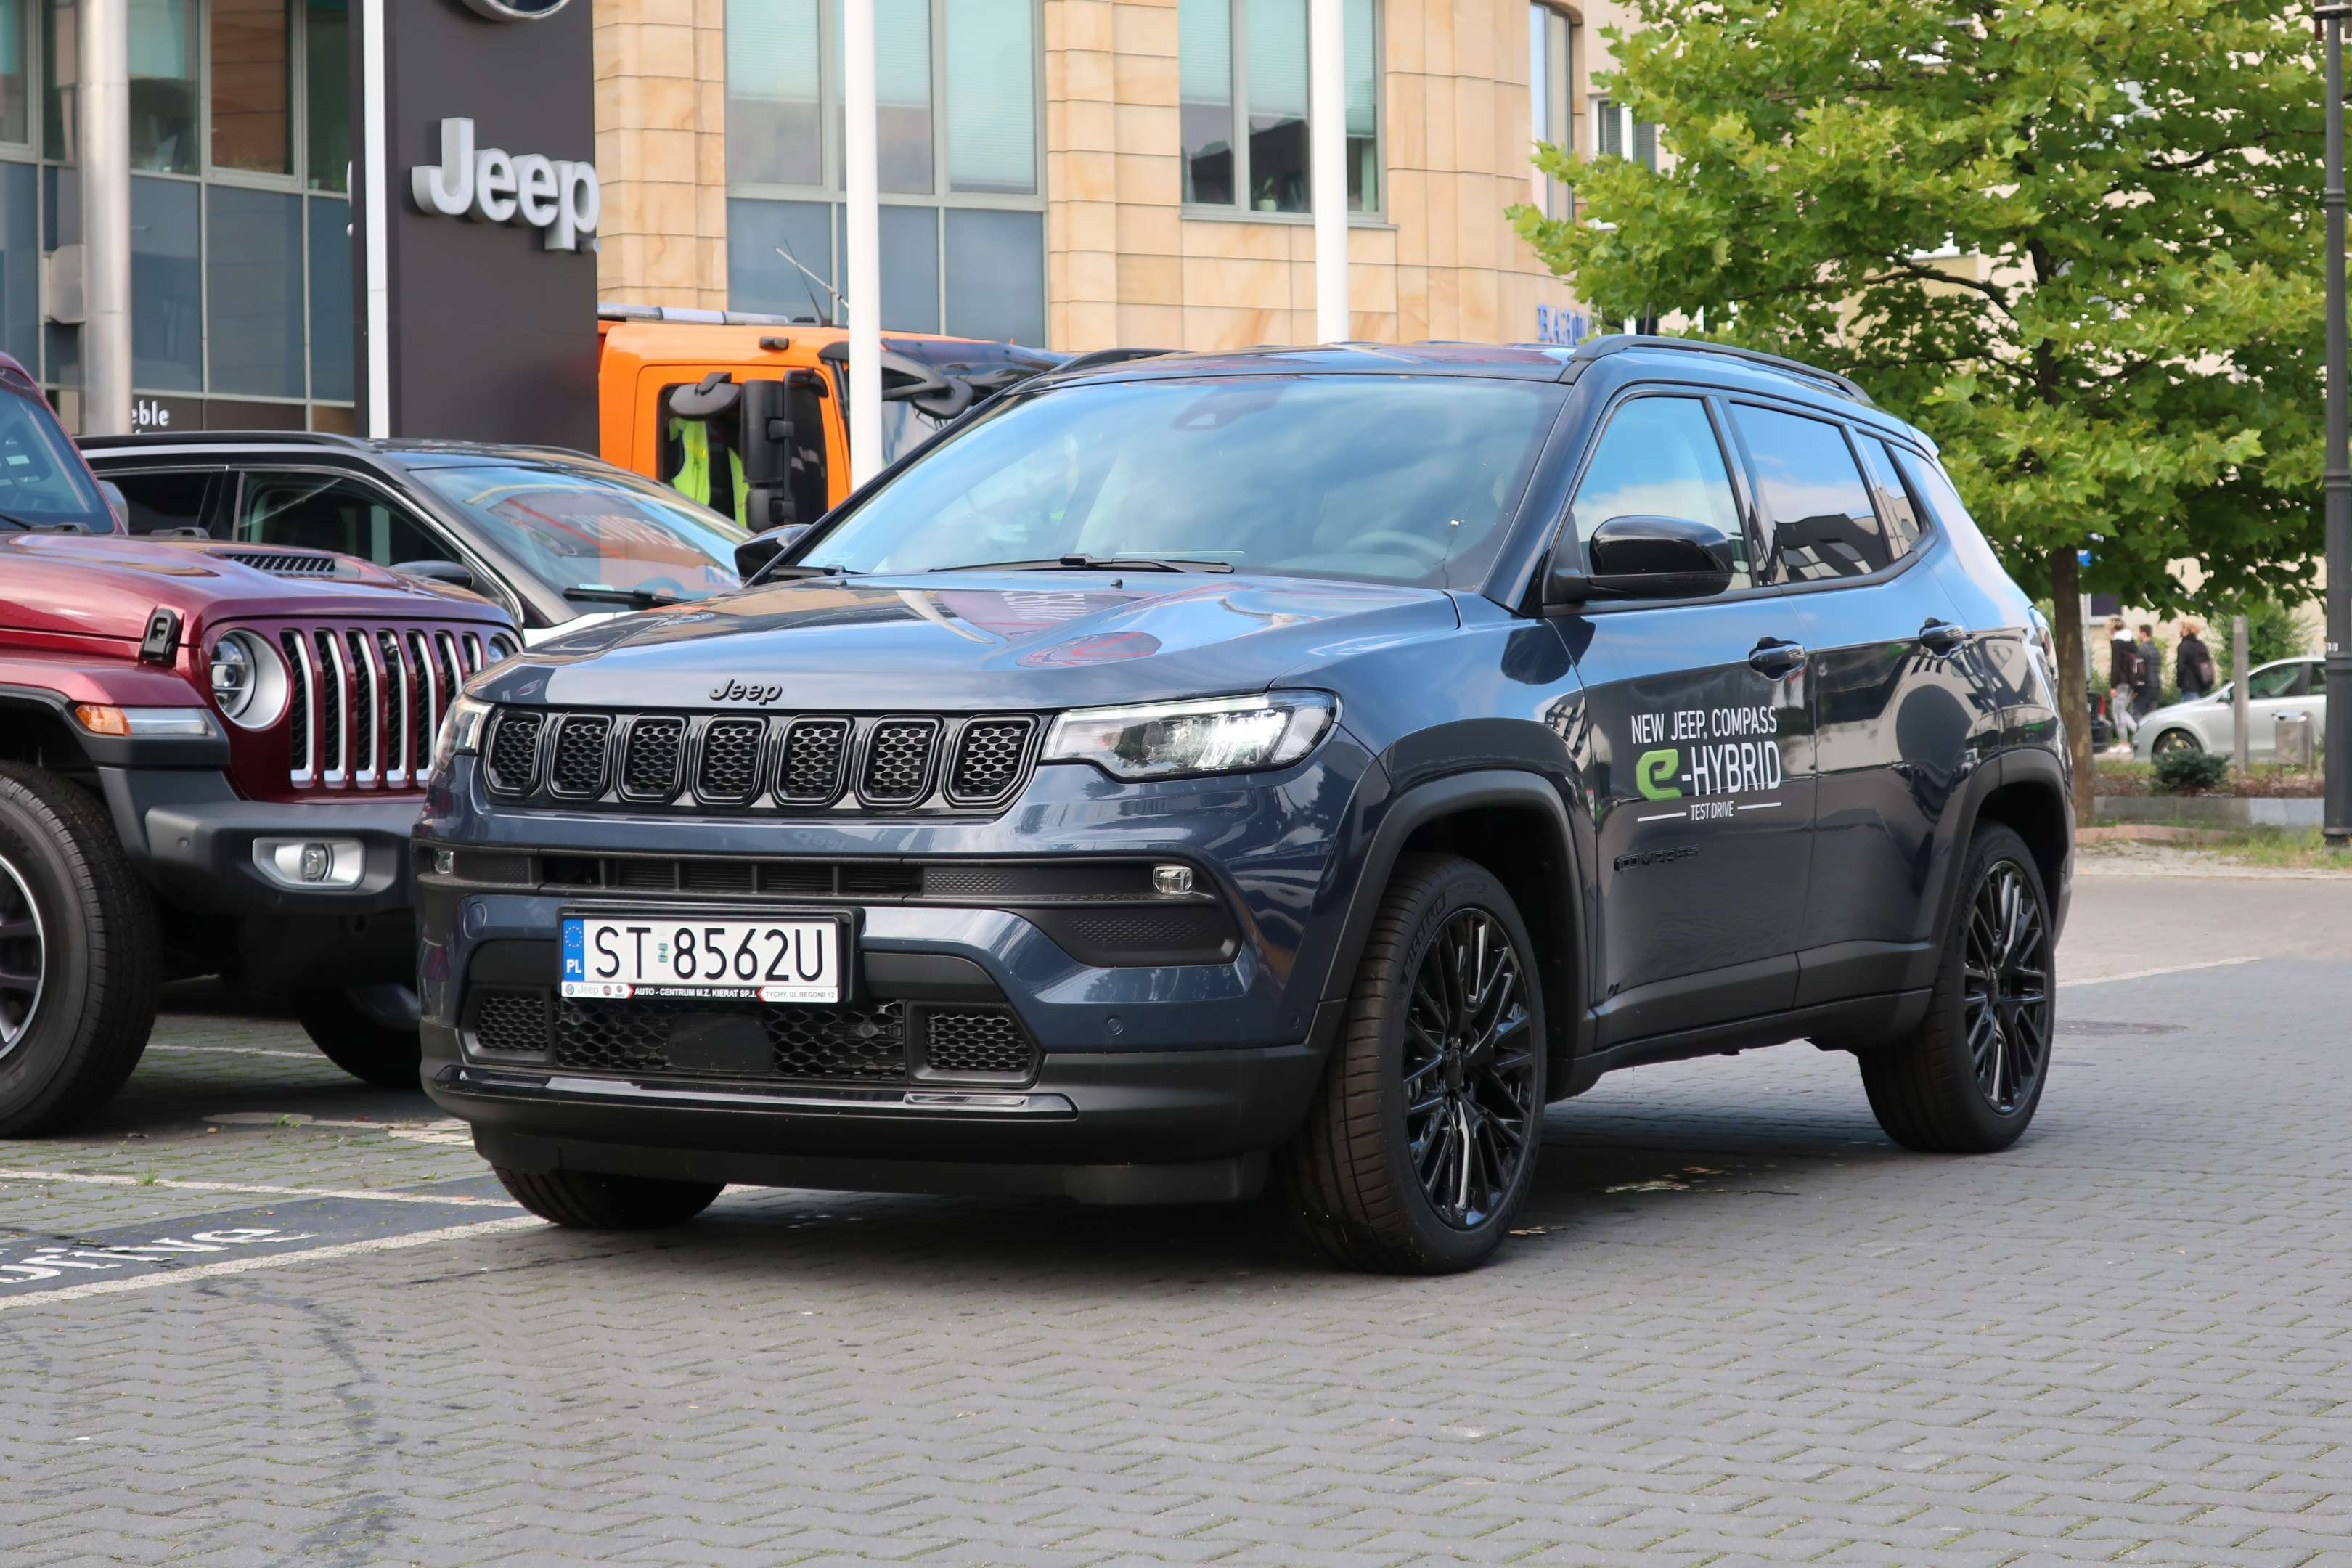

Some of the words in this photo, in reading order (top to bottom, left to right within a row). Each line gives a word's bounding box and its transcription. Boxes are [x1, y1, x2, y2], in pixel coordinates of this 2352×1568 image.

[411, 117, 600, 250] Jeep
[709, 679, 783, 706] Jeep
[1631, 713, 1665, 744] NEW
[1712, 706, 1778, 737] COMPASS
[1691, 803, 1710, 820] TEST
[1711, 801, 1734, 819] DRIVE
[566, 959, 582, 973] PL
[595, 926, 651, 979] ST
[674, 928, 822, 981] 8562U
[634, 987, 654, 996] AUTO
[660, 988, 695, 997] CENTRUM
